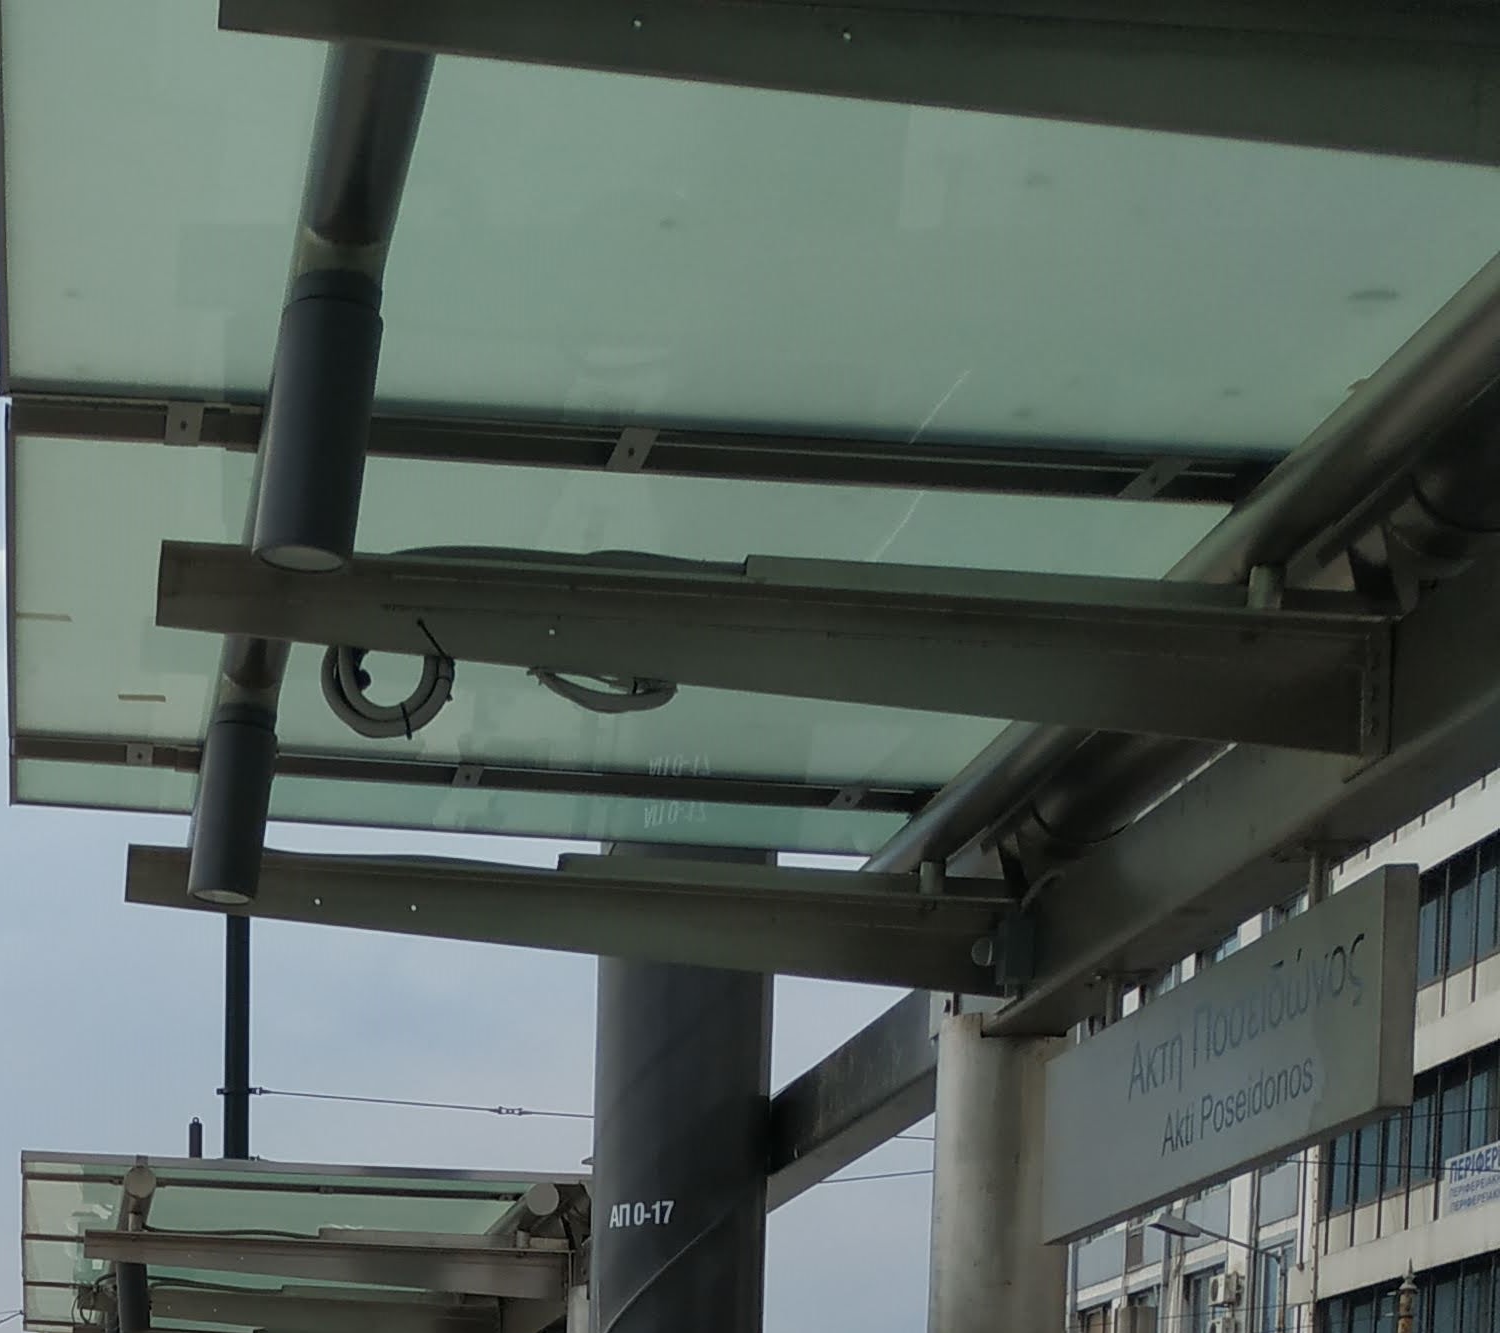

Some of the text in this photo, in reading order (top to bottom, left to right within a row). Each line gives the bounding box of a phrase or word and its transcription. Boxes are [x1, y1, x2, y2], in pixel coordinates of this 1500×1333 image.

[1161, 1057, 1313, 1158] Akti Poseidonos
[1449, 1147, 1500, 1184] ΠΕΡΙΦΕΡ
[634, 1200, 675, 1226] 0-17
